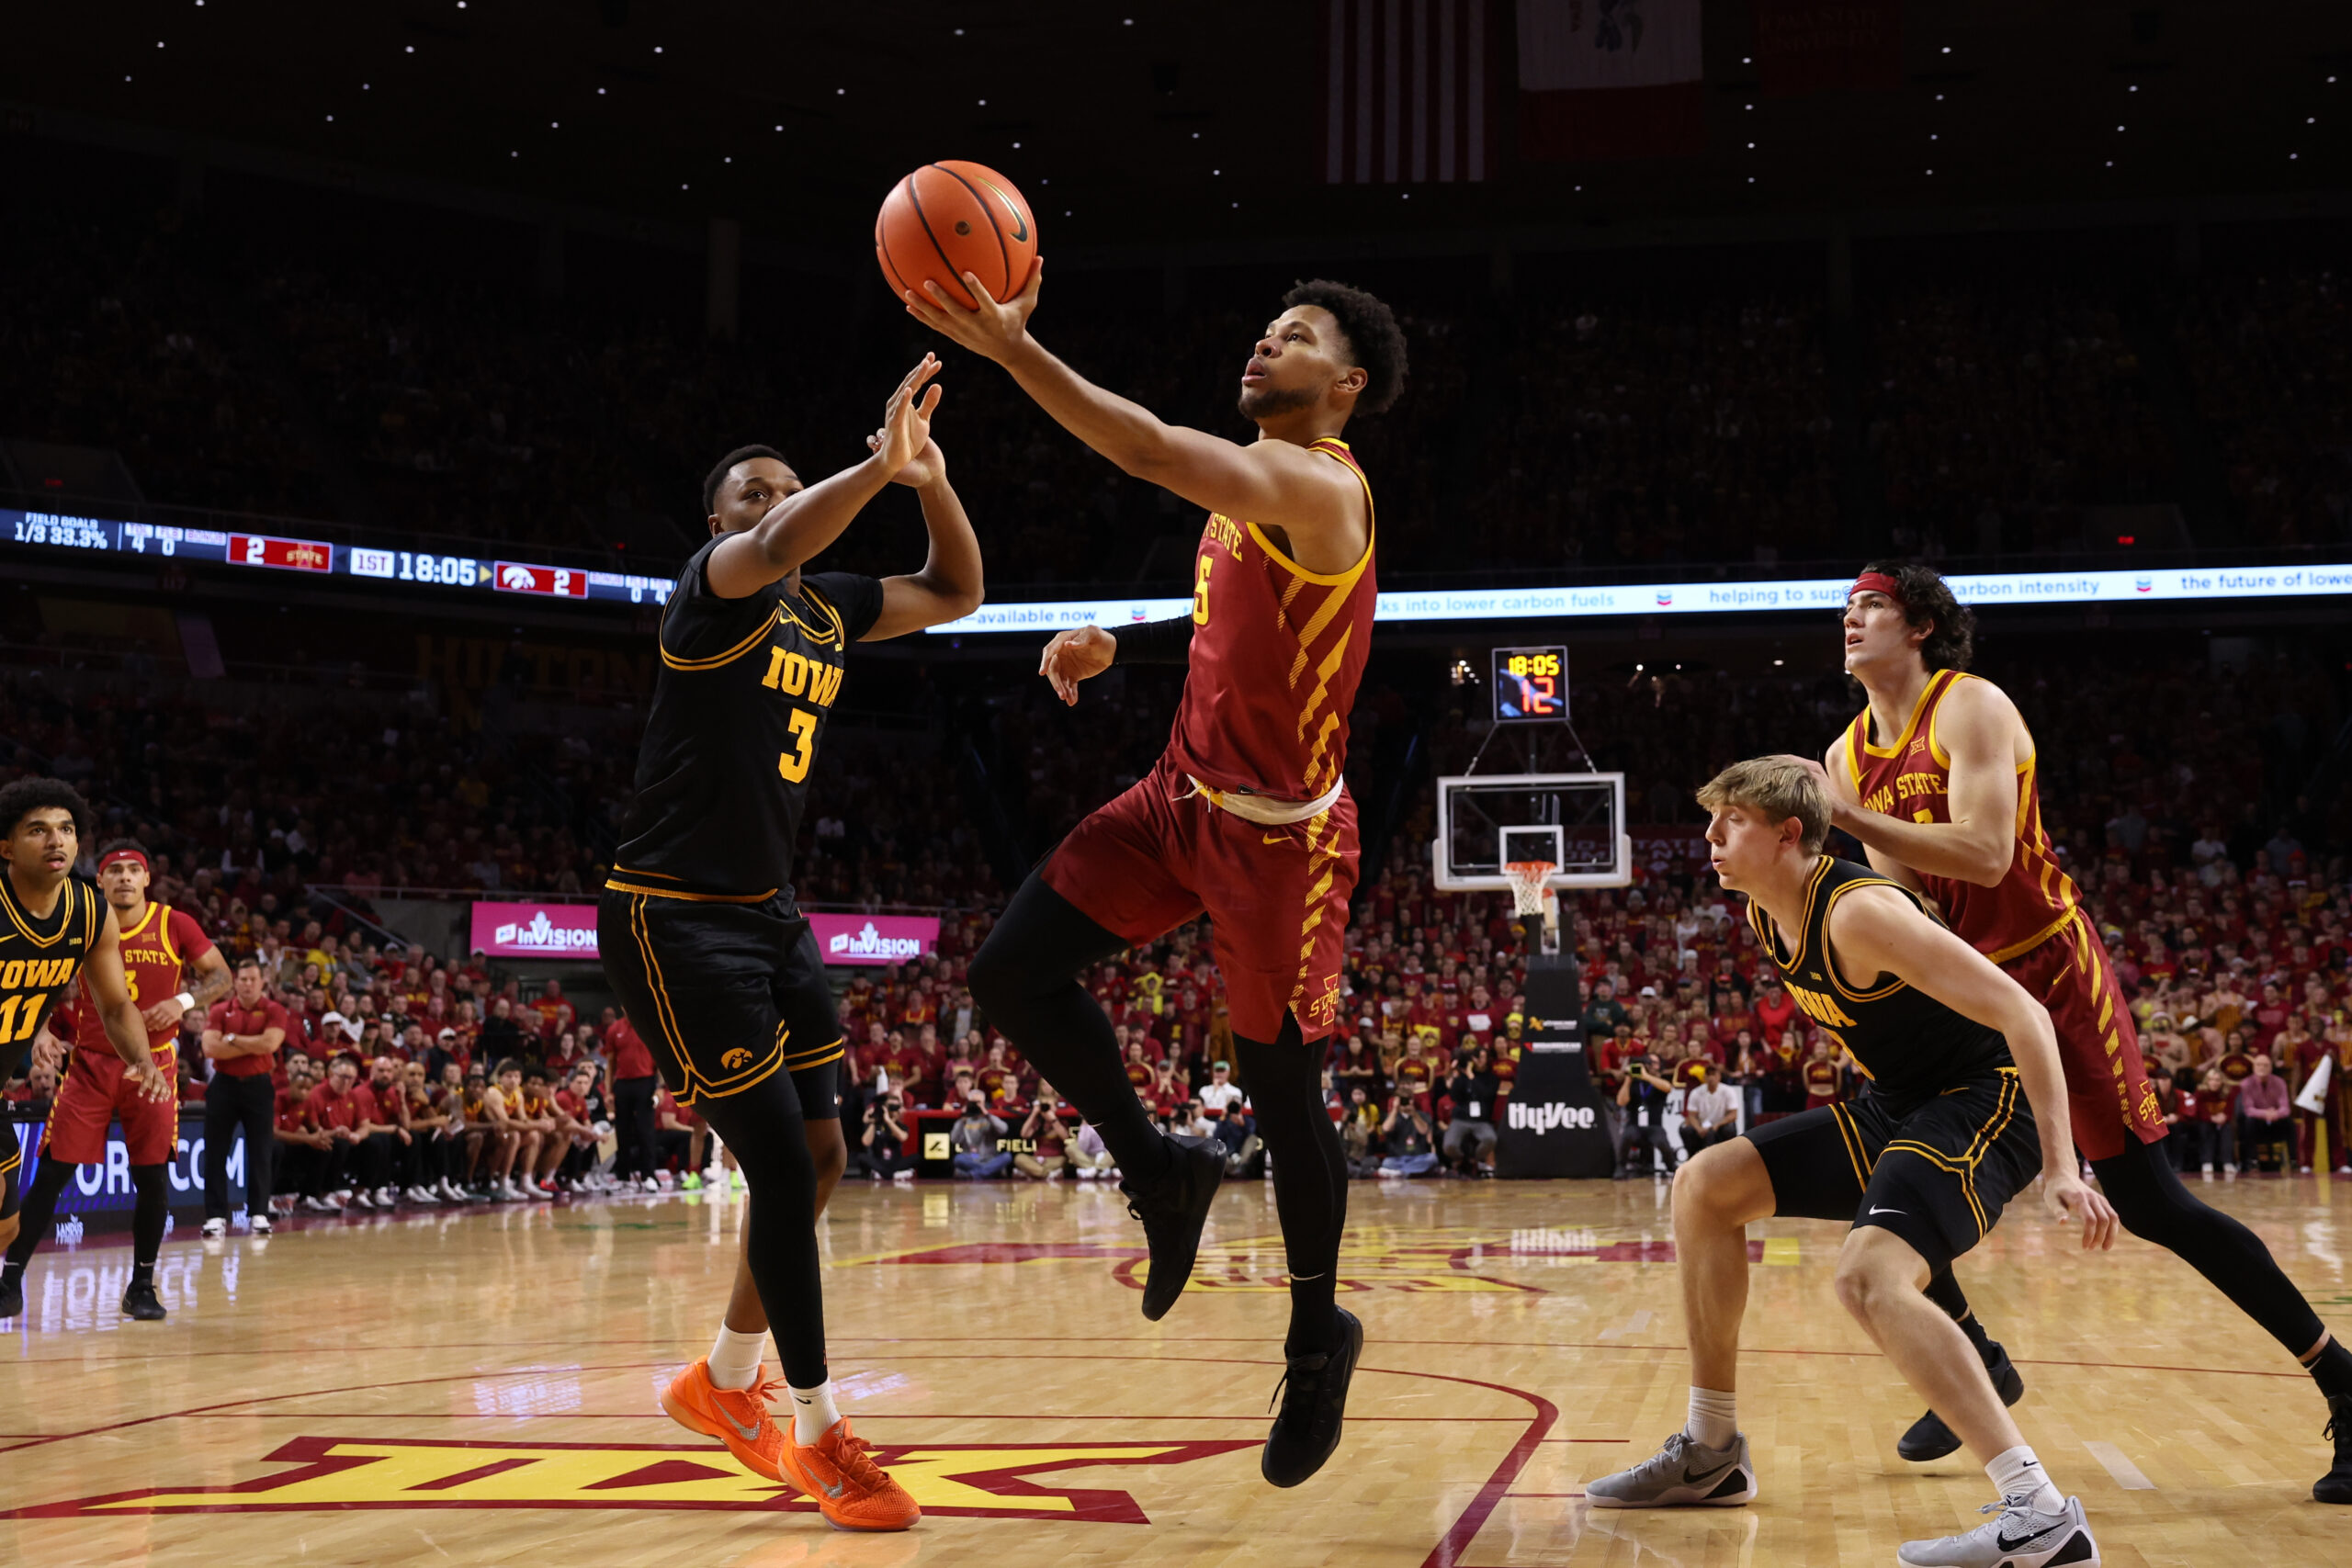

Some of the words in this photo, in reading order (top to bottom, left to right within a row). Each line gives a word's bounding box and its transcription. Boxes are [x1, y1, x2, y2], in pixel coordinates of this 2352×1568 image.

[26, 512, 60, 526] FIELD
[61, 515, 98, 531] GOALS
[131, 535, 145, 553] 4
[162, 537, 175, 556] 0
[1210, 513, 1243, 563] STATE
[246, 537, 266, 565] 2
[357, 554, 387, 571] 1ST
[399, 552, 477, 586] 18:05
[2182, 575, 2211, 590] the
[2219, 574, 2276, 588] future
[2283, 572, 2301, 586] of
[553, 569, 571, 595] 2
[1193, 554, 1214, 626] 5
[1710, 589, 1778, 605] helping
[1785, 589, 1804, 602] to
[2019, 580, 2100, 595] intensity
[631, 586, 642, 603] 0
[655, 588, 667, 605] 4
[1406, 596, 1441, 612] into
[1446, 595, 1495, 611] lower
[1502, 594, 1564, 610] carbon
[1571, 592, 1614, 608] fuels
[1060, 609, 1097, 622] now
[1509, 654, 1560, 677] 18:05
[1521, 676, 1555, 714] 12
[778, 707, 818, 784] 3
[1895, 772, 1948, 800] STATE
[849, 930, 920, 955] InVISION
[125, 949, 169, 965] STATE
[0, 993, 48, 1044] 11
